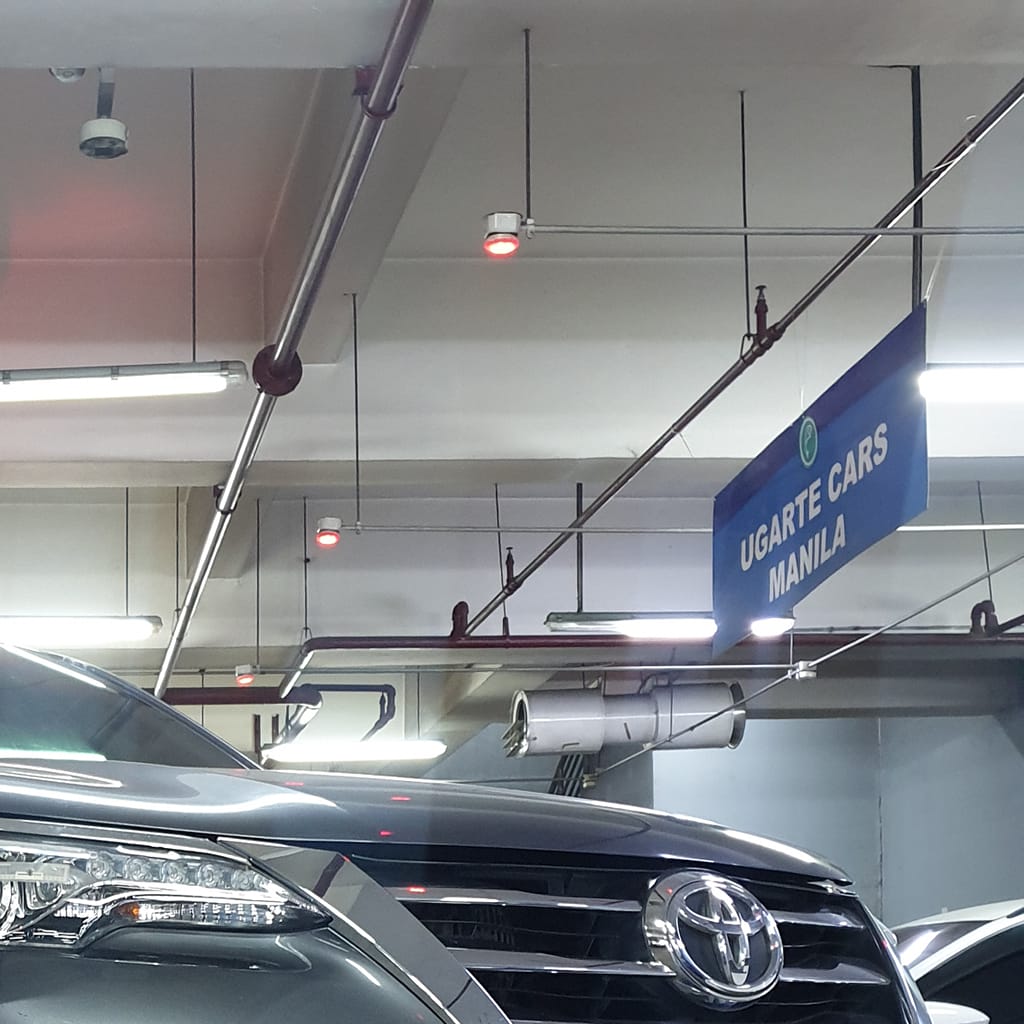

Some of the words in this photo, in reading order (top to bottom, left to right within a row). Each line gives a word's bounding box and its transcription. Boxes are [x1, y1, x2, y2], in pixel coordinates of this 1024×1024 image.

[740, 478, 822, 572] UGARTE
[827, 422, 889, 503] CARS
[769, 513, 847, 602] MANILA
